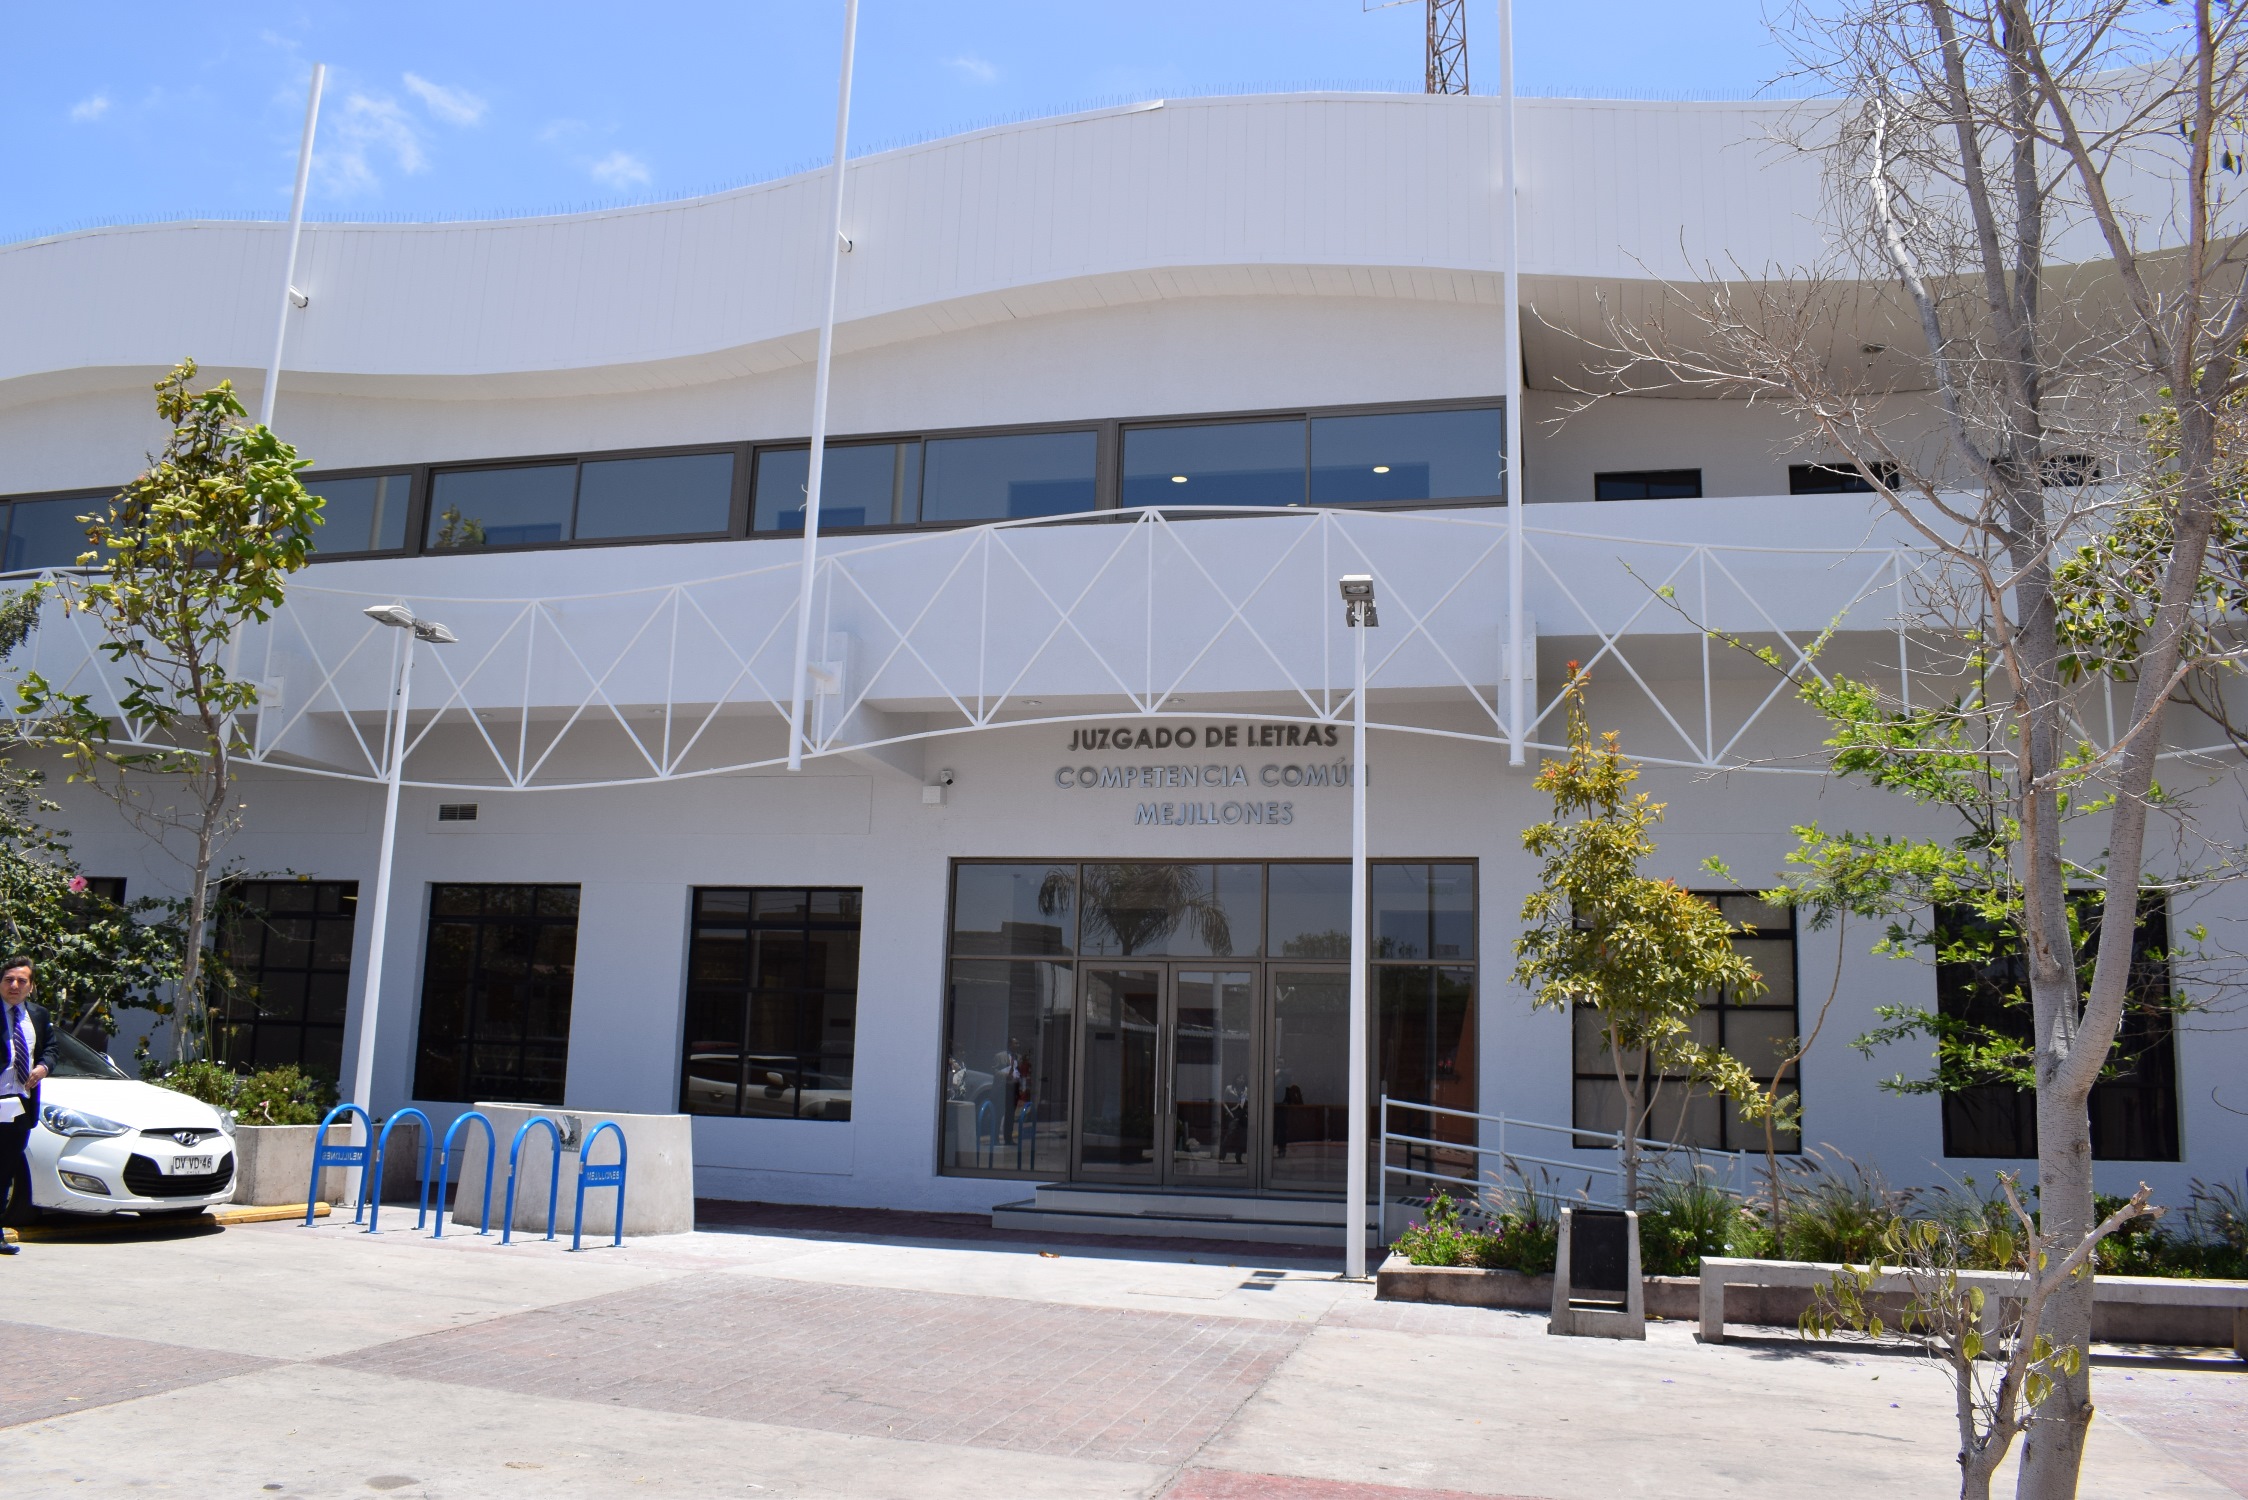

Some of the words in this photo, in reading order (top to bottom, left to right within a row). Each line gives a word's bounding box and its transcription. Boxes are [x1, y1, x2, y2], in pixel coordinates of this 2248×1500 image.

[1067, 727, 1196, 751] JUZGADO
[1205, 726, 1238, 748] DE
[1248, 725, 1338, 747] LETRAS
[1055, 764, 1249, 789] COMPETENCIA
[1134, 801, 1294, 827] MEJILLONES
